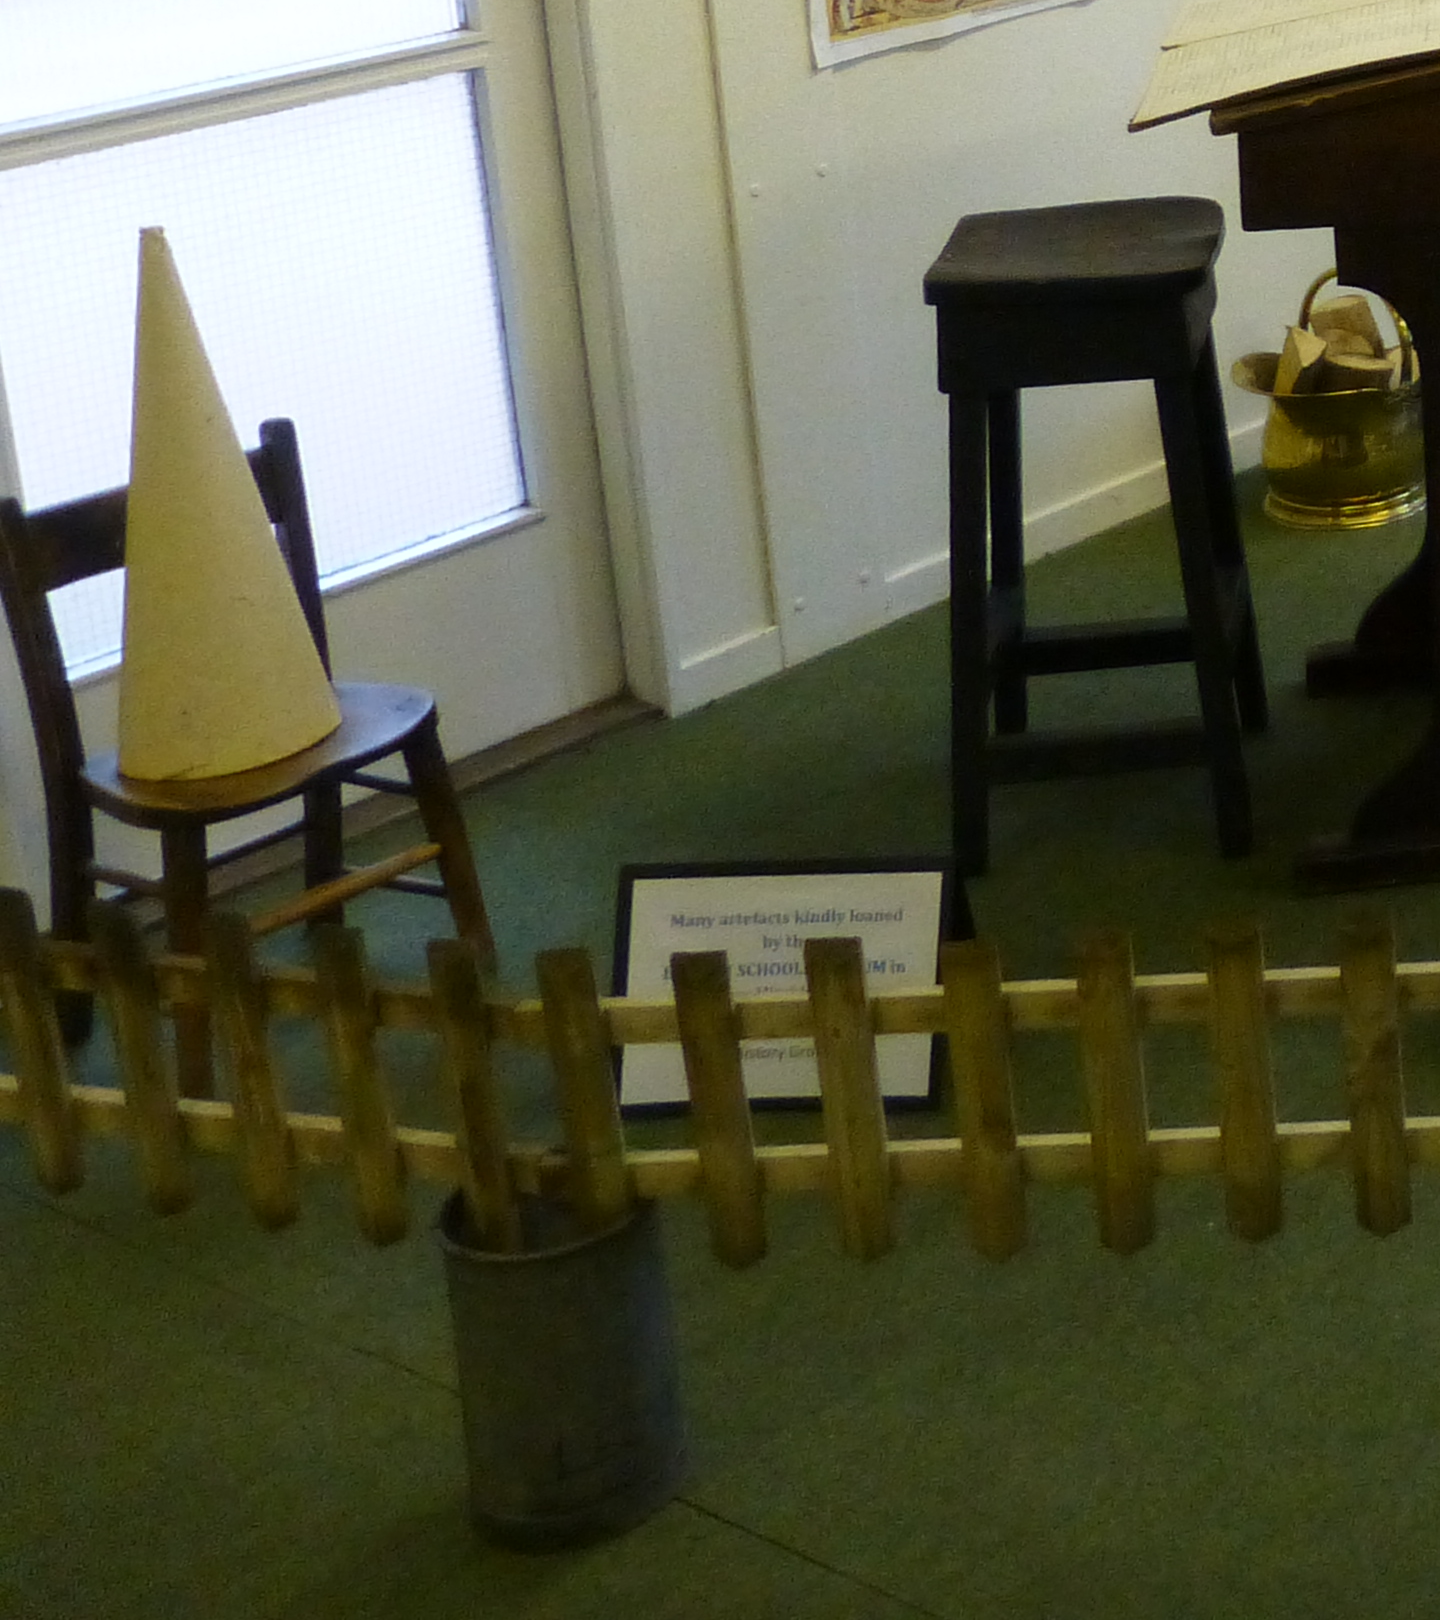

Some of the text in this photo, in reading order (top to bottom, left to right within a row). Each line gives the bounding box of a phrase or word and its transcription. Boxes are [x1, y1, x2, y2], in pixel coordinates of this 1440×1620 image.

[671, 913, 715, 929] Many
[794, 908, 846, 925] kindly
[850, 908, 903, 923] loaned
[763, 935, 783, 952] by
